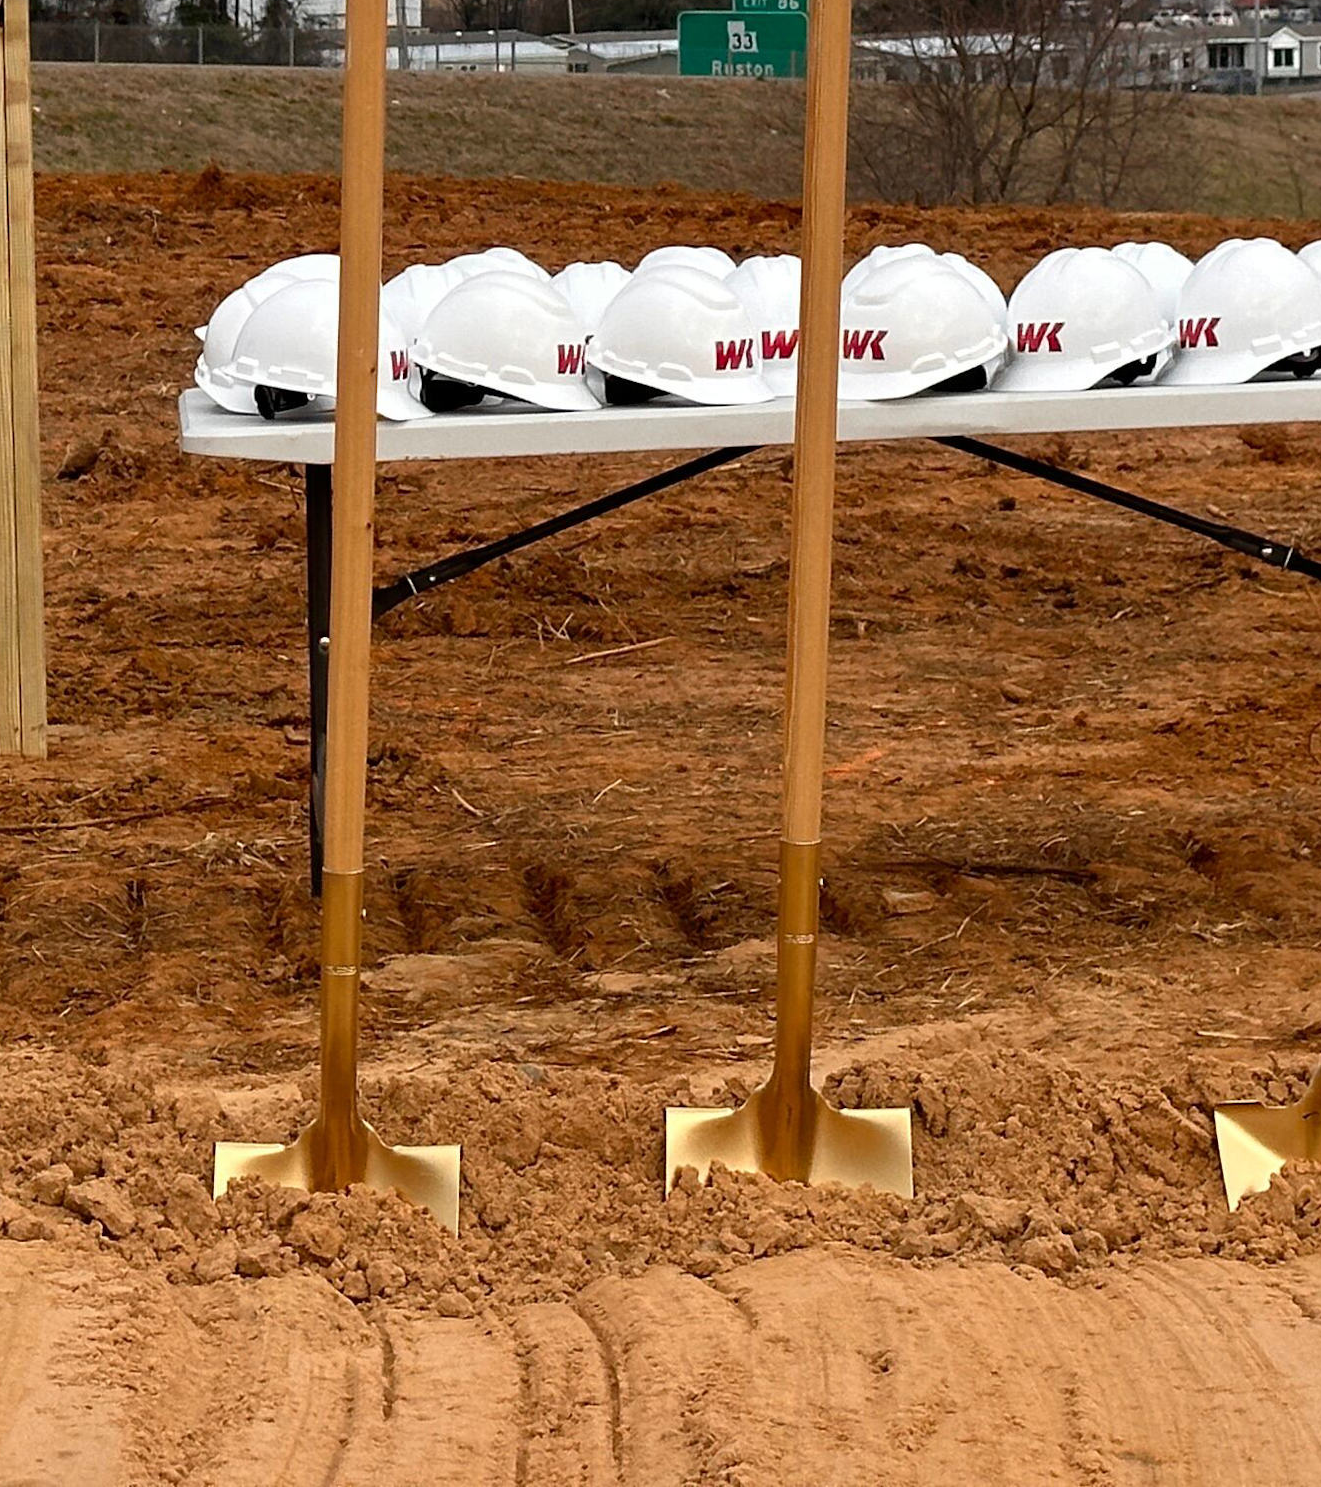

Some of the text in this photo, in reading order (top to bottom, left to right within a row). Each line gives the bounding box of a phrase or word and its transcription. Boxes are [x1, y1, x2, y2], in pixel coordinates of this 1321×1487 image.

[731, 33, 753, 50] 33
[711, 60, 774, 76] Ruston
[761, 329, 800, 360] W
[843, 329, 888, 361] WK
[1017, 321, 1065, 353] WK
[1179, 317, 1221, 349] WK
[390, 351, 409, 381] W
[557, 344, 585, 374] W
